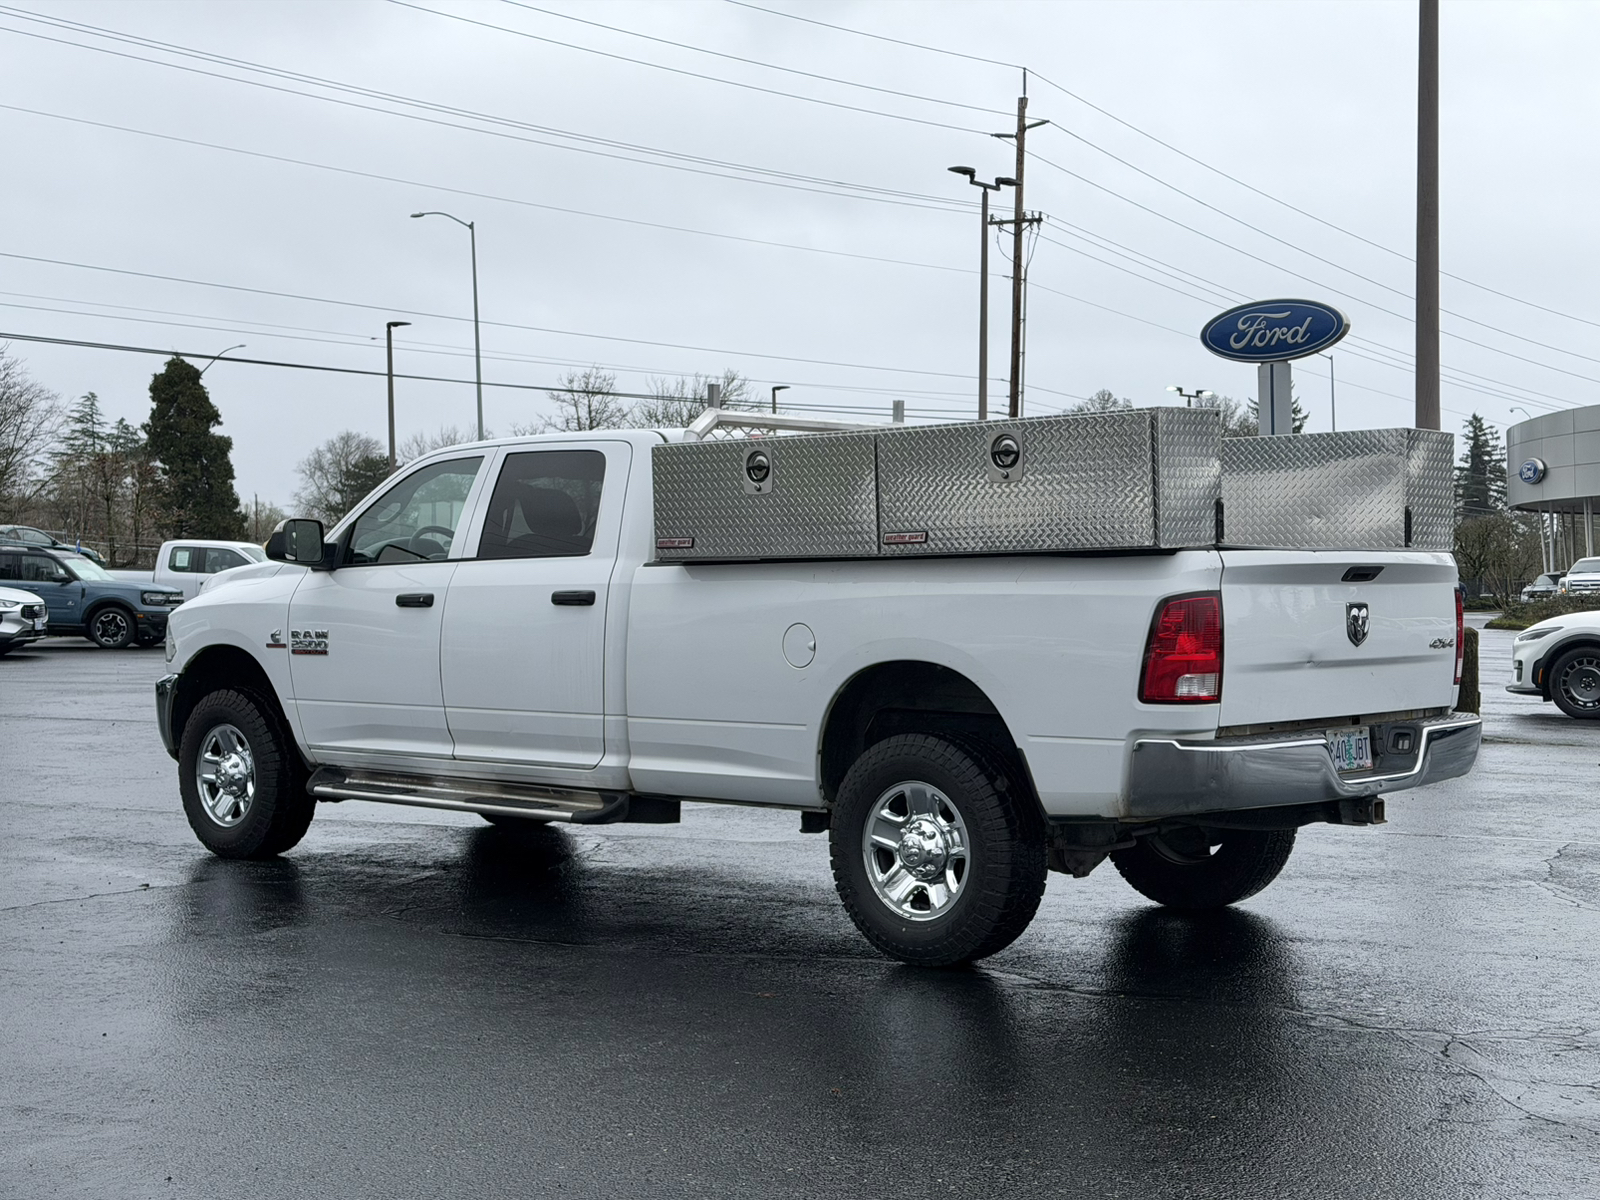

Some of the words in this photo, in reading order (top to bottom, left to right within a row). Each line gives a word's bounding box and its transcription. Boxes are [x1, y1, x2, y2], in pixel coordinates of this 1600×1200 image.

[1229, 310, 1312, 349] Ford
[1522, 464, 1535, 479] Ford
[290, 629, 329, 640] RAM
[290, 640, 329, 649] 2500
